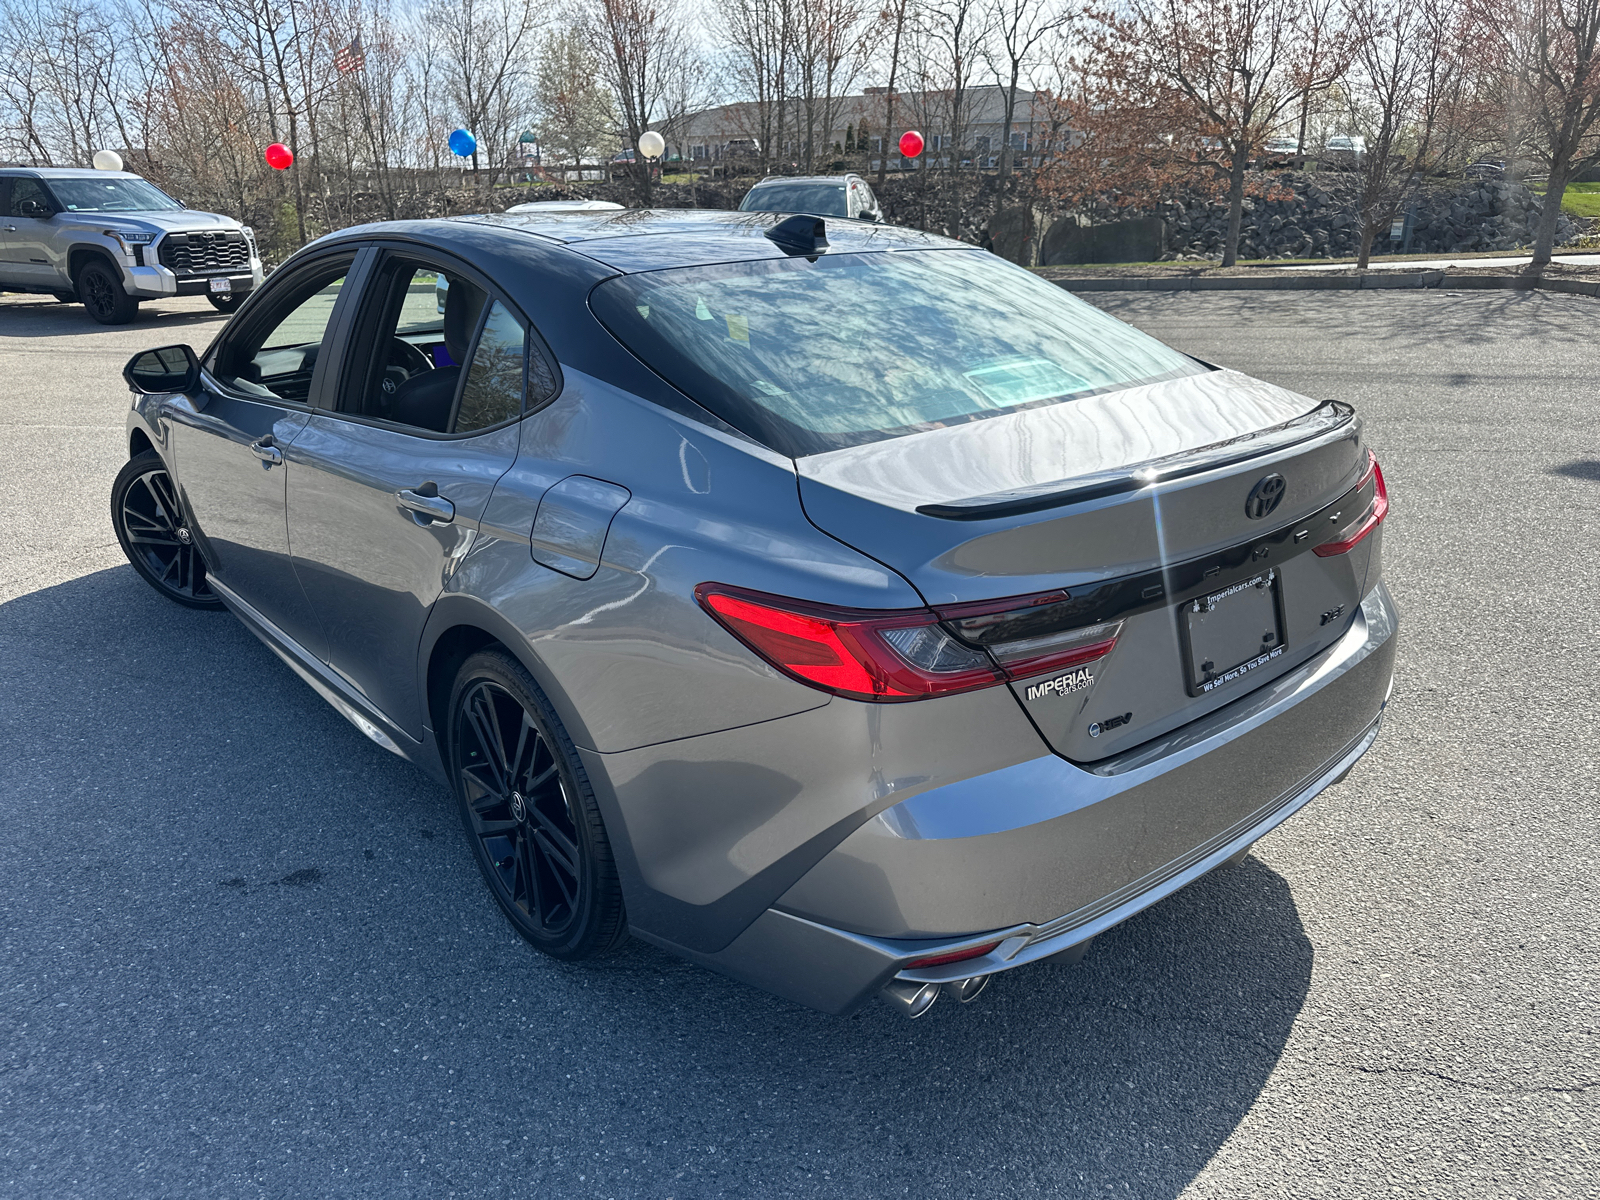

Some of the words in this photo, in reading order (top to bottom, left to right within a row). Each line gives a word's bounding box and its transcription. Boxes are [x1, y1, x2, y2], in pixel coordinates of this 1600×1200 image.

[1141, 511, 1341, 599] CAMRY
[1206, 576, 1263, 604] Imperialcars.com
[1319, 603, 1345, 626] XSE
[1026, 667, 1094, 701] IMPERIAL
[1204, 683, 1213, 692] We
[1214, 678, 1223, 687] Sell
[1225, 671, 1239, 682] More,
[1240, 667, 1247, 675] So
[1248, 662, 1257, 670] You
[1258, 655, 1269, 665] Save
[1270, 648, 1282, 658] More
[1059, 678, 1095, 697] cars.com
[1098, 711, 1133, 734] HEV
